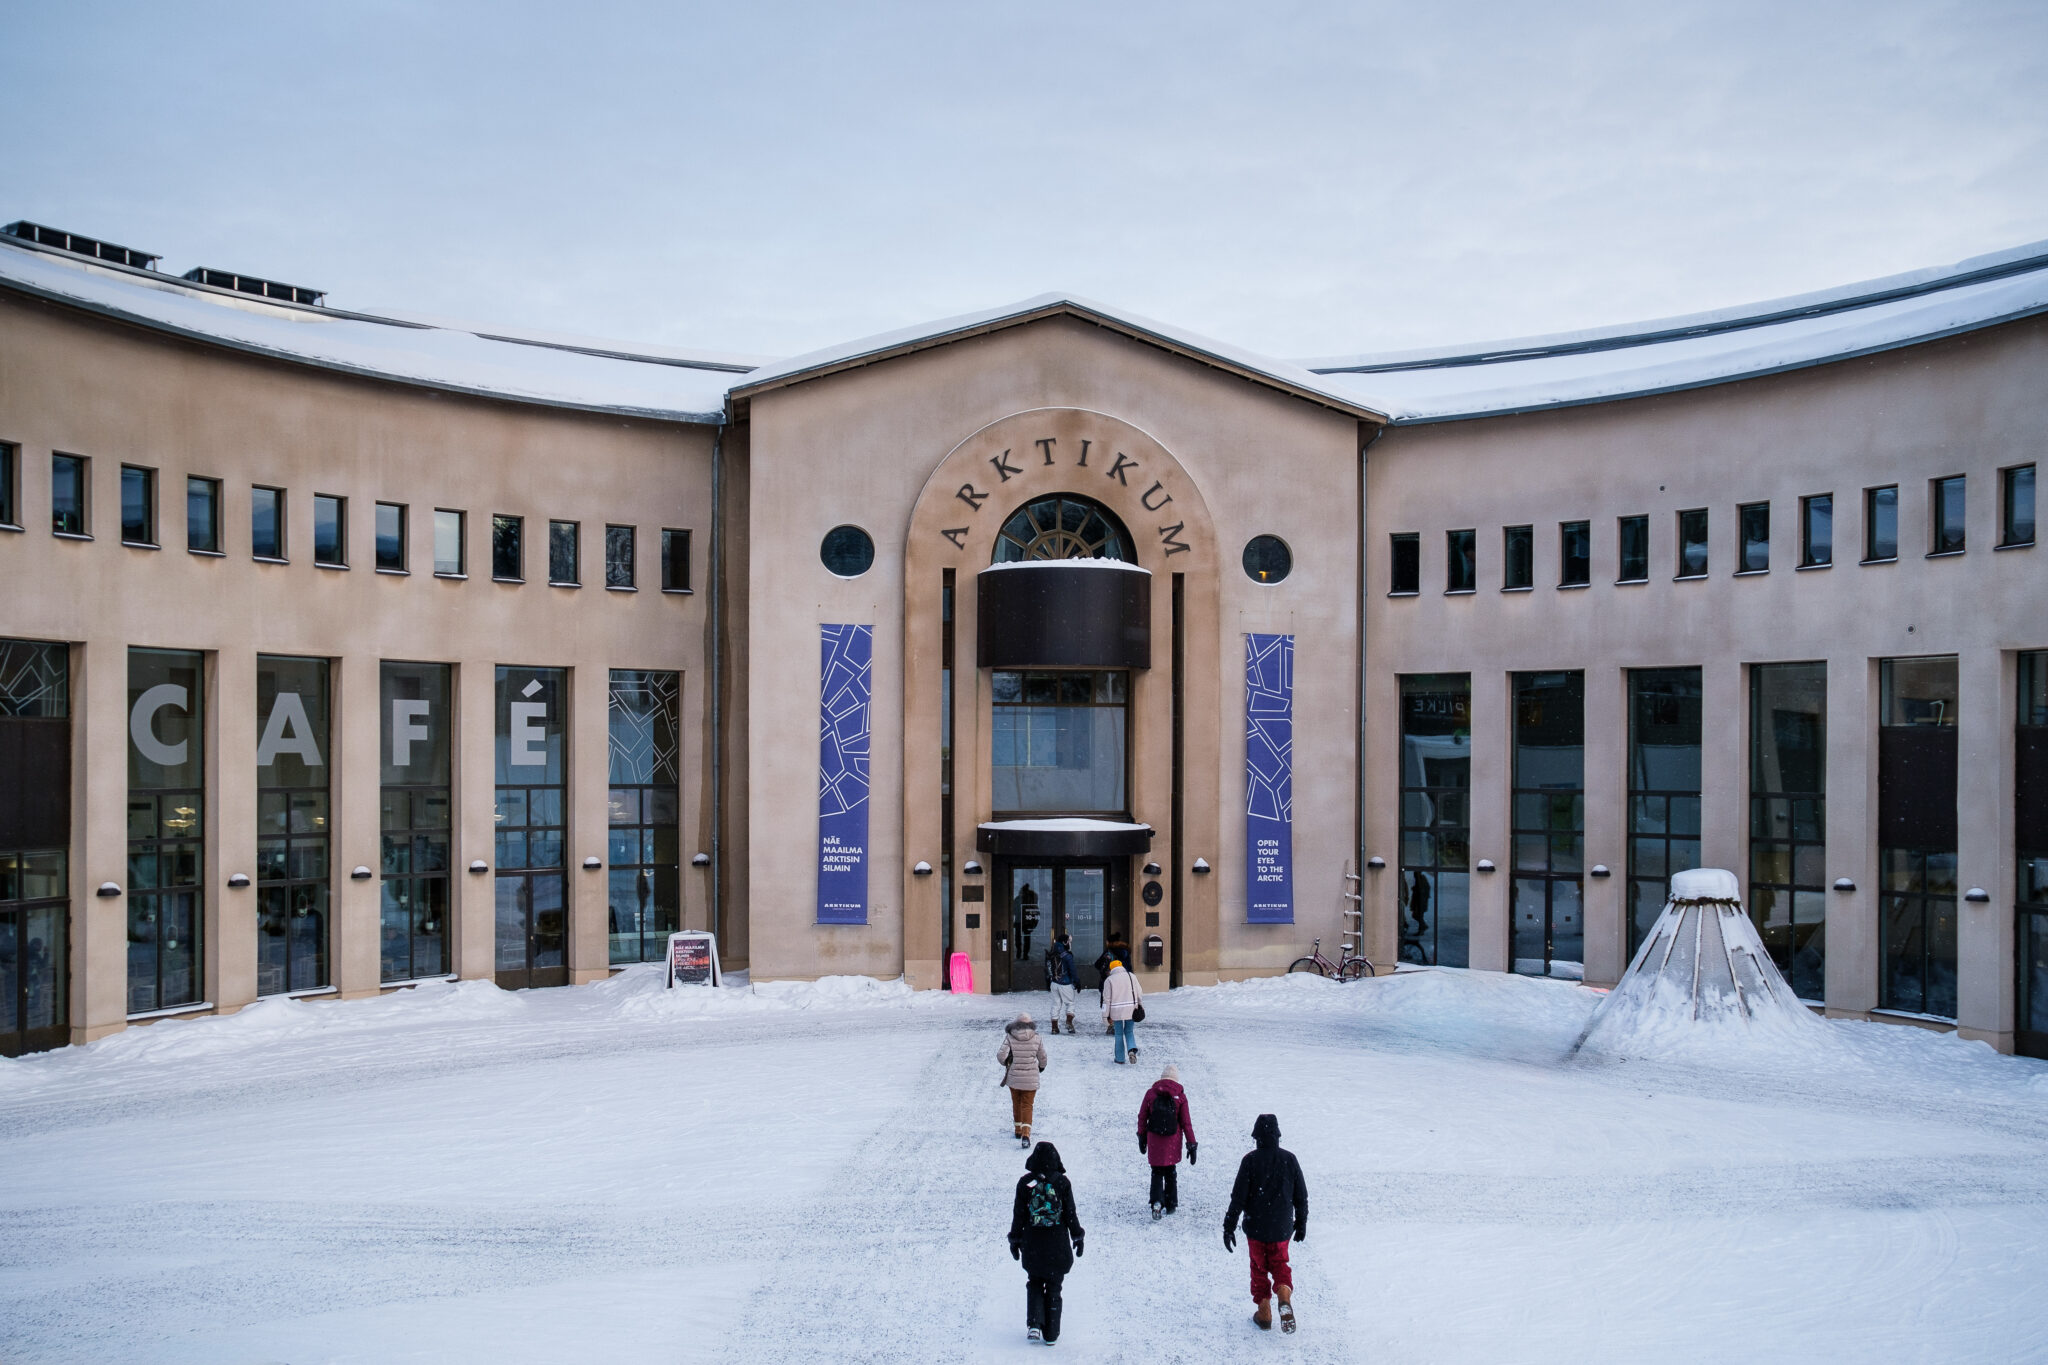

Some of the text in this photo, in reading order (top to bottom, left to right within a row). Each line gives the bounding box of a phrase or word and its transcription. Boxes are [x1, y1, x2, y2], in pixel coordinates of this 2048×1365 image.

[941, 437, 1191, 558] ARKTIKUM
[130, 678, 547, 766] CAFÉ
[823, 836, 840, 844] NÄE
[823, 846, 863, 854] MAAILMA
[1257, 848, 1279, 856] YOUR
[823, 855, 860, 863] ARKTISIN
[823, 864, 851, 872] SILMIN
